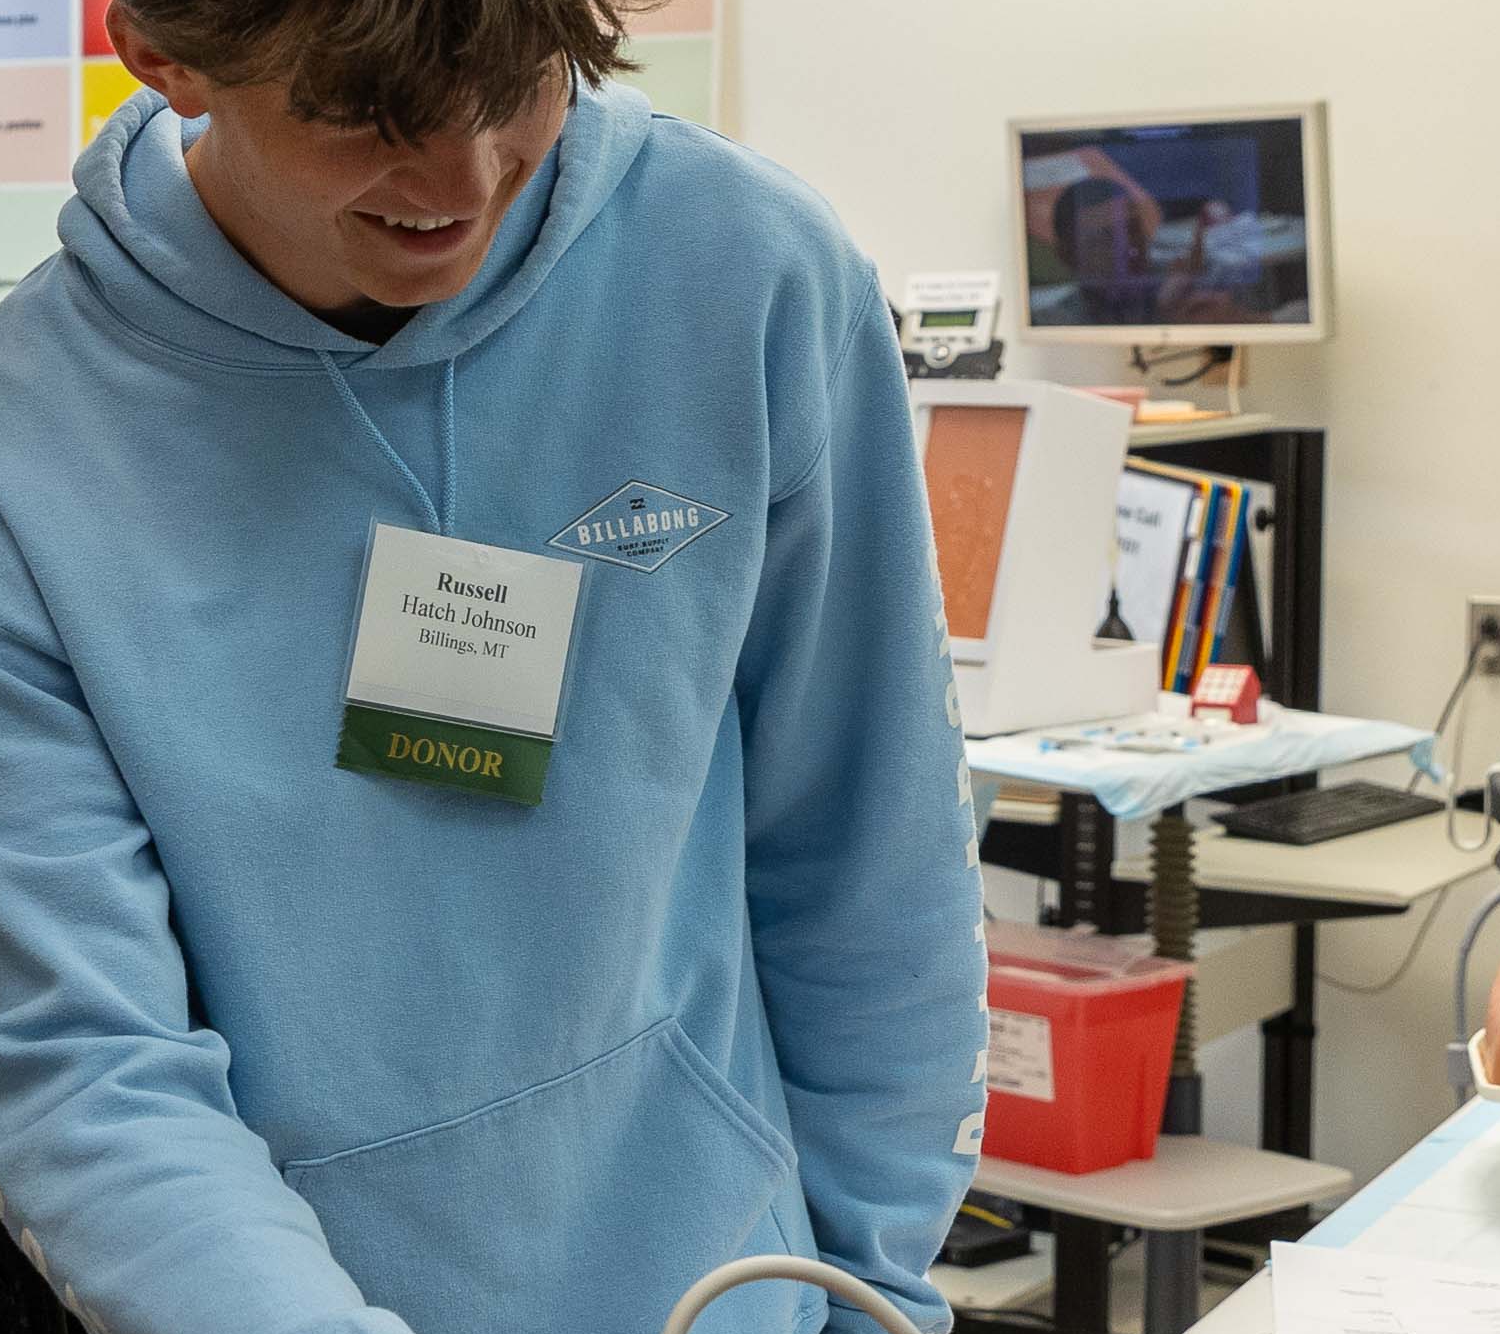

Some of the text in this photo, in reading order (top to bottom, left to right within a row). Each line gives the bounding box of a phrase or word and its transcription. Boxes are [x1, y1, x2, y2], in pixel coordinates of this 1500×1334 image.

[577, 507, 699, 545] BILLABONG
[626, 545, 664, 557] COMPANY
[437, 571, 508, 603] Russell
[401, 594, 537, 639] Hatch Johnson
[418, 628, 510, 658] Billings, MT
[387, 732, 503, 778] DONOR
